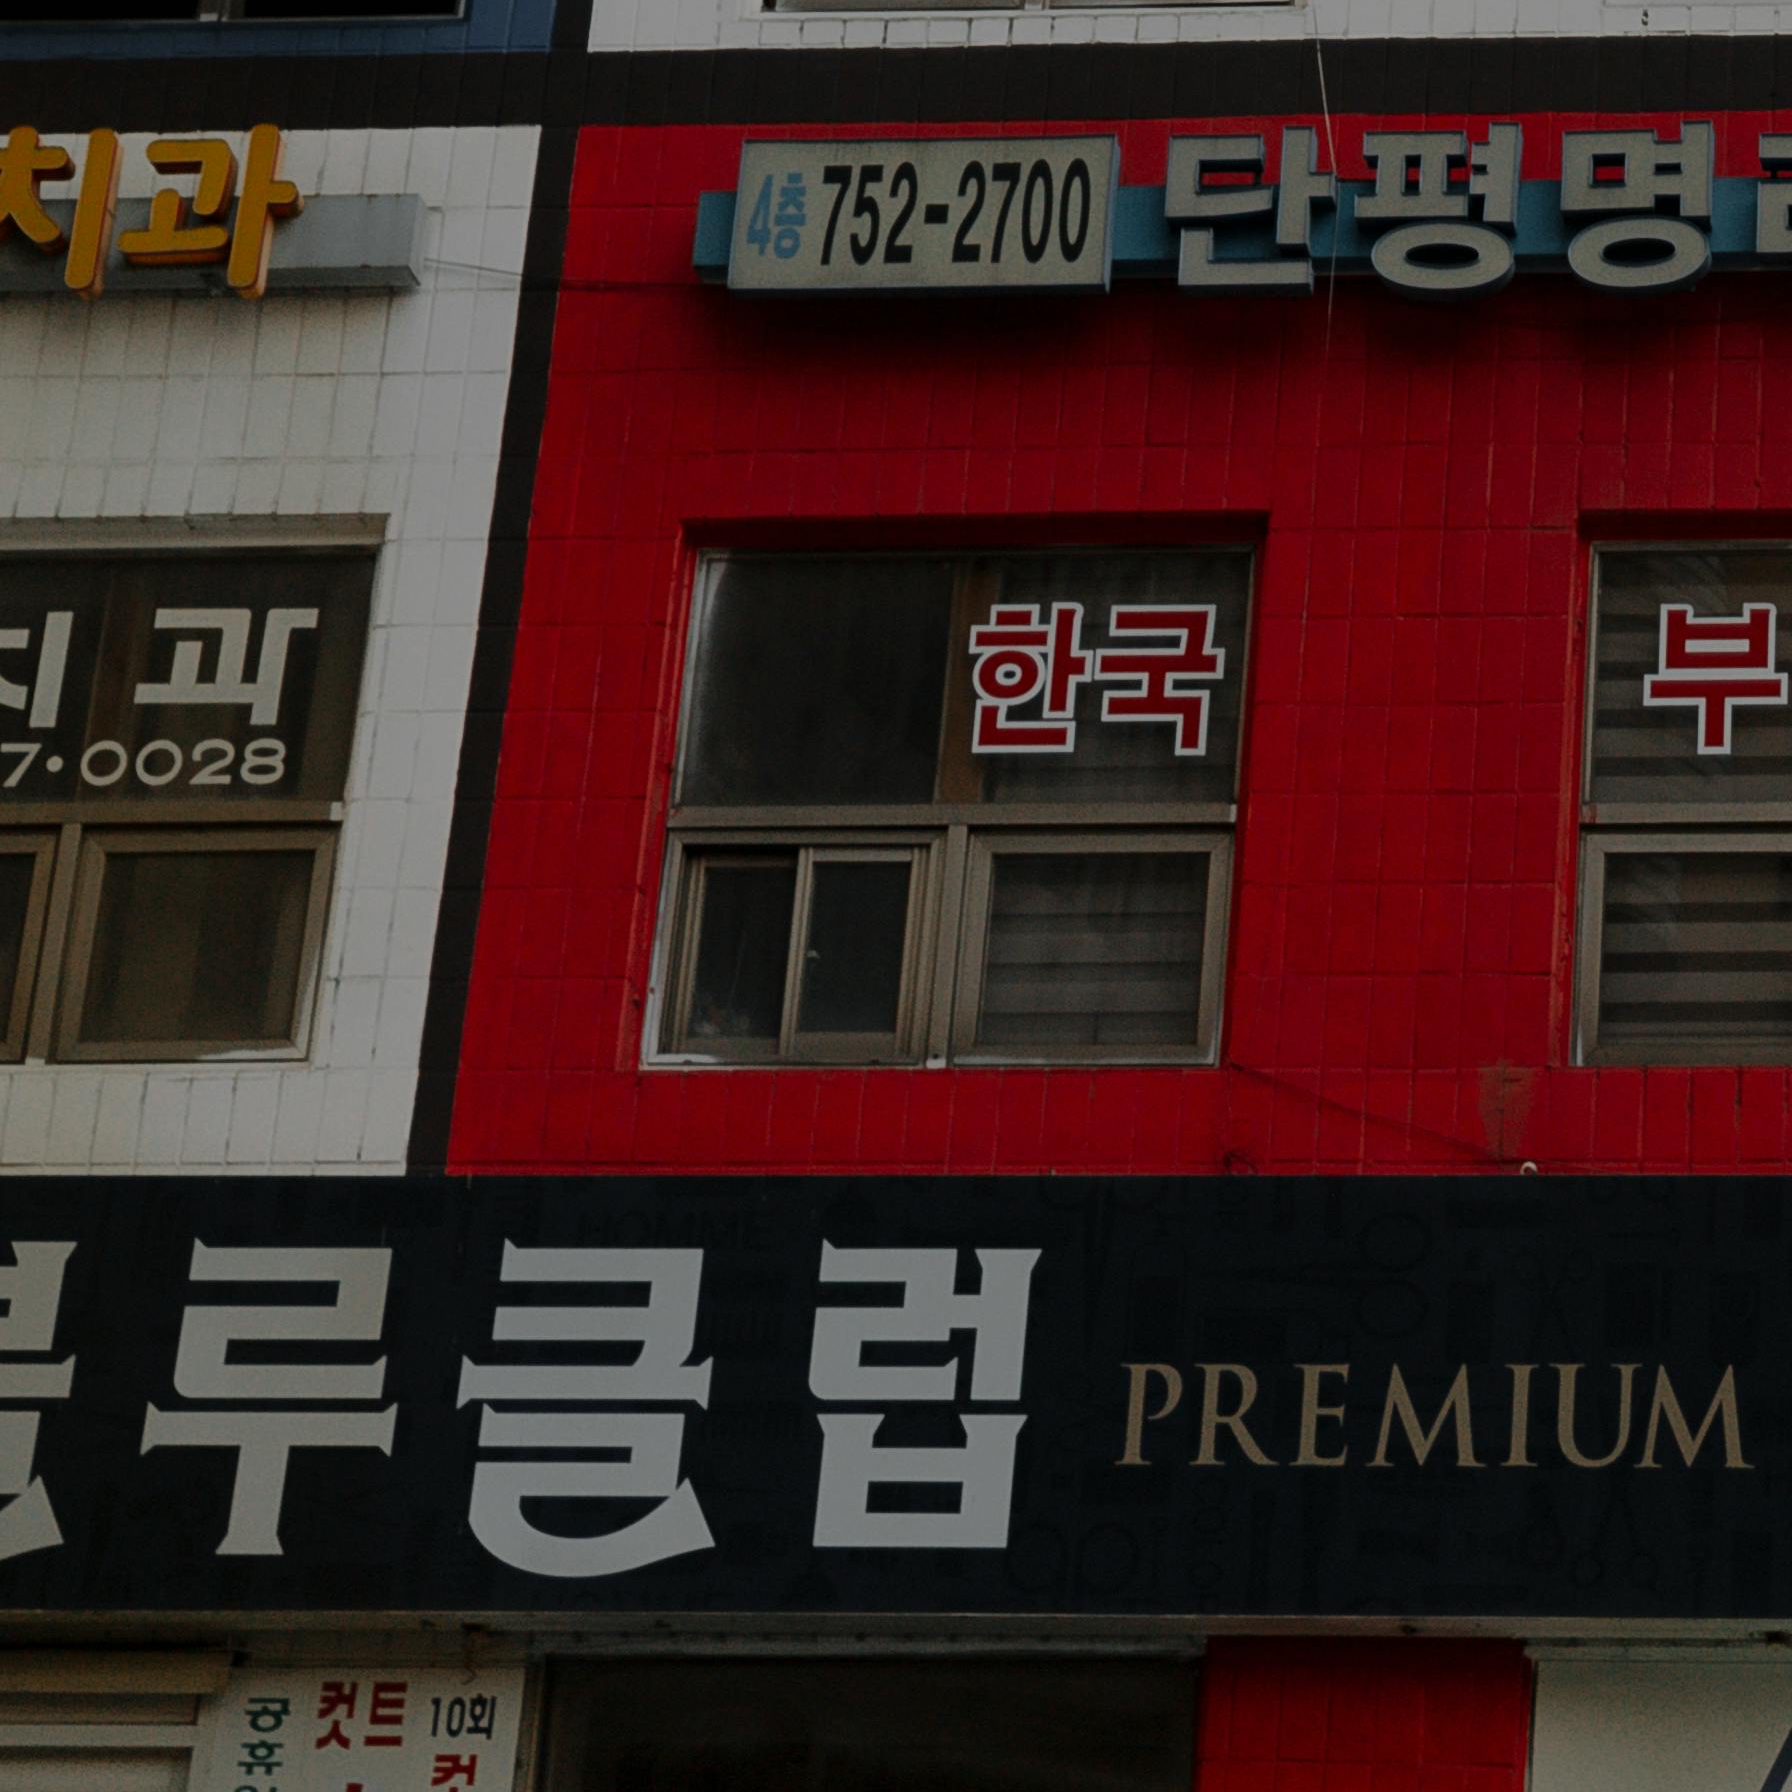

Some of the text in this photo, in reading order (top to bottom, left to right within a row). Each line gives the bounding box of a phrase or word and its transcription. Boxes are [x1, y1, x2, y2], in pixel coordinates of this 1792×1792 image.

[746, 171, 807, 259] 4층
[821, 157, 1091, 267] 752-2700
[968, 602, 1226, 757] 한국
[1115, 1362, 1755, 1471] PREMIUM
[233, 1696, 291, 1792] 공휴
[315, 1681, 408, 1750] 컷트
[430, 1694, 498, 1740] 10회
